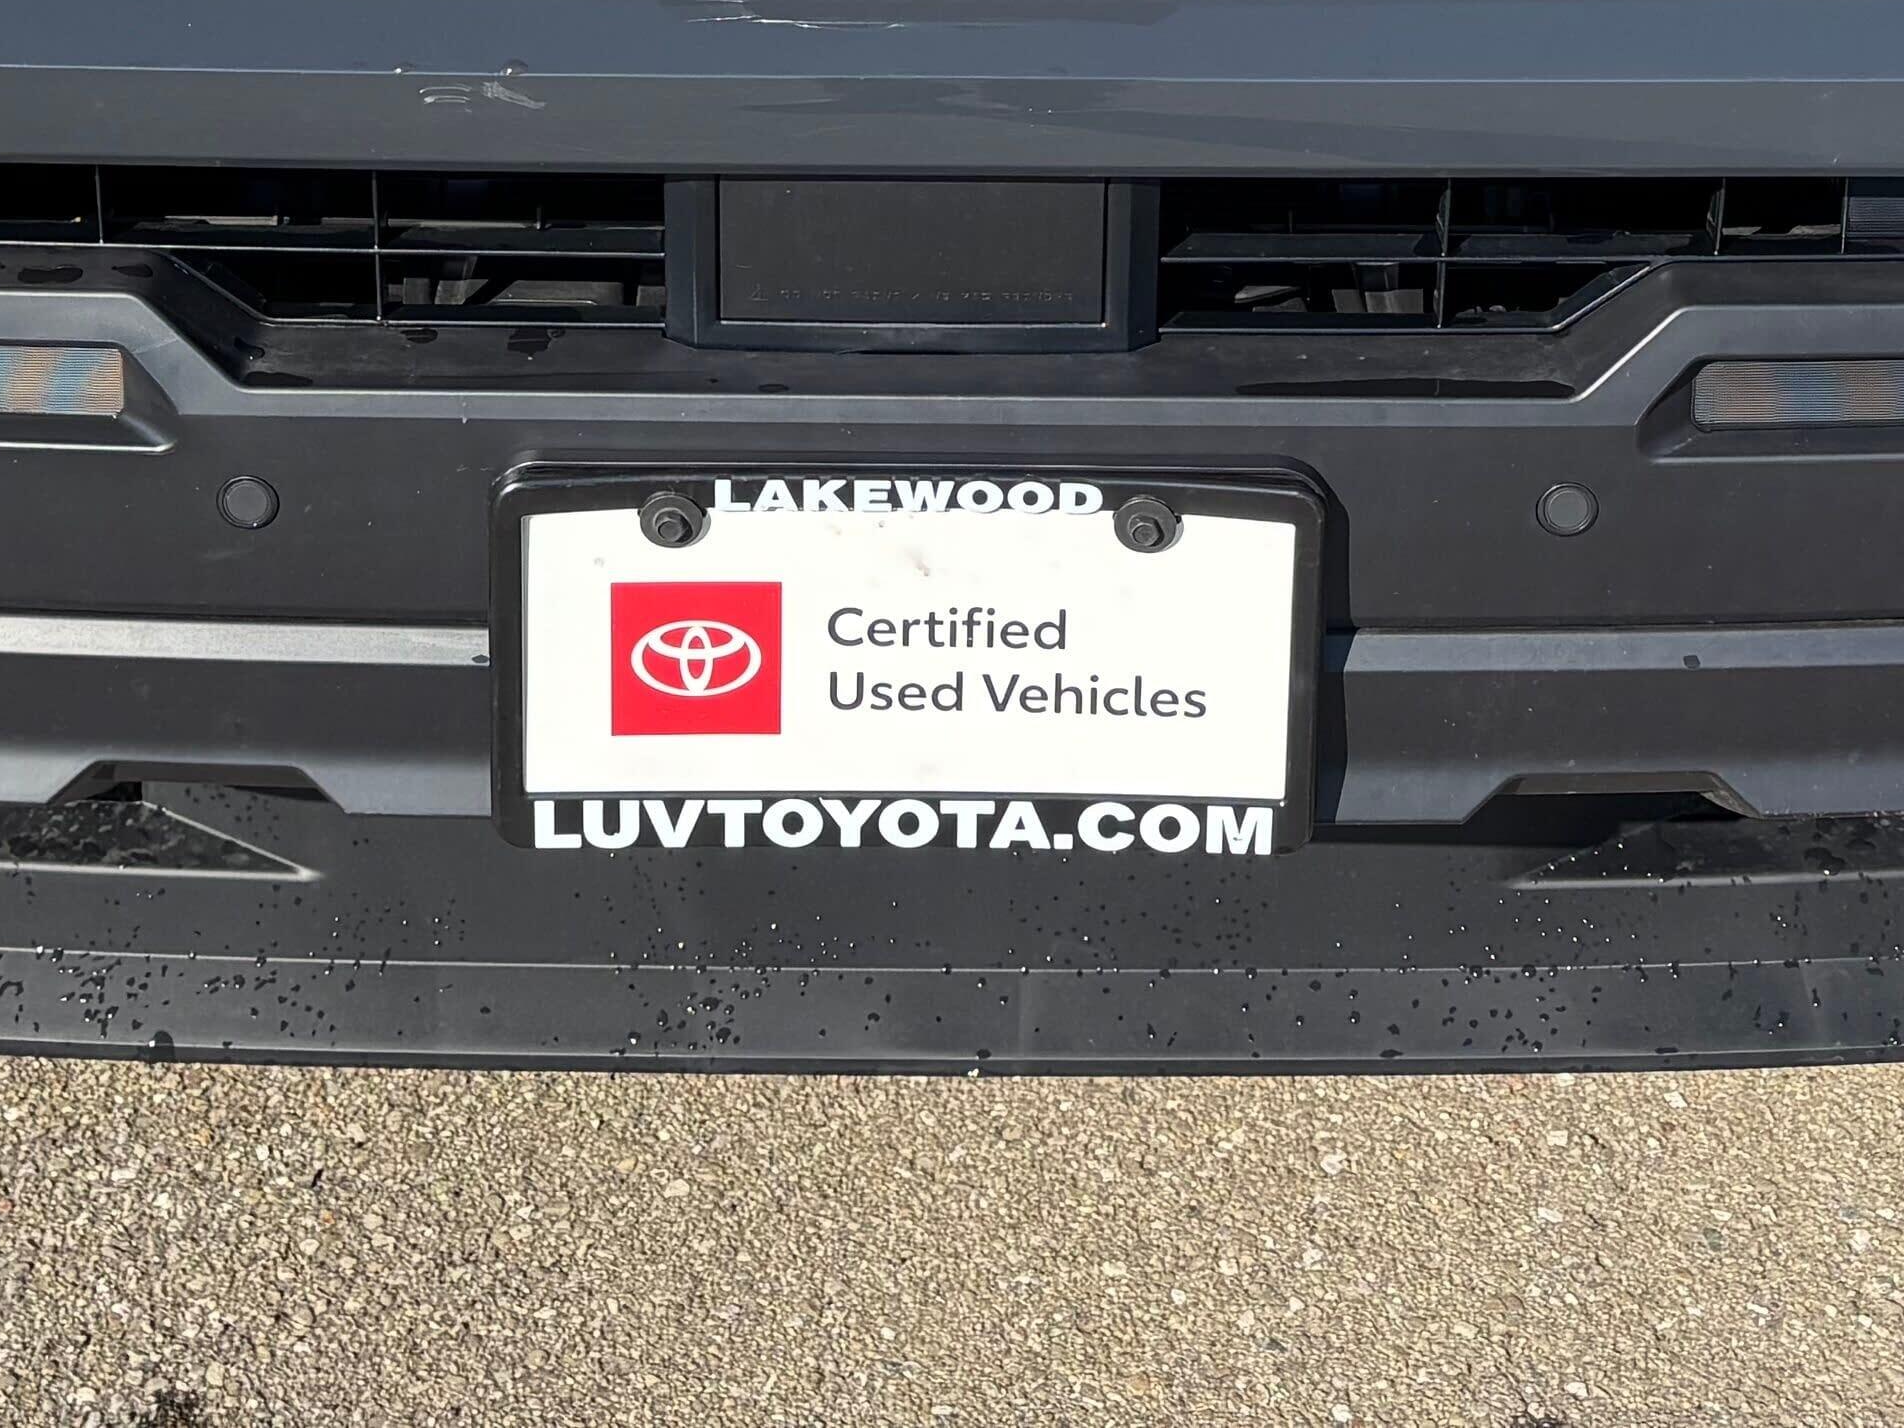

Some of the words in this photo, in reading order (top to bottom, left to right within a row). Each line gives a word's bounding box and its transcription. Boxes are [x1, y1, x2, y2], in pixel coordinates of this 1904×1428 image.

[714, 479, 1103, 516] LAKEWOOD
[827, 607, 1069, 652] Certified
[827, 671, 964, 713] Used
[981, 673, 1208, 720] Vehicles
[533, 798, 1275, 857] LUVTOYOTA.COM
